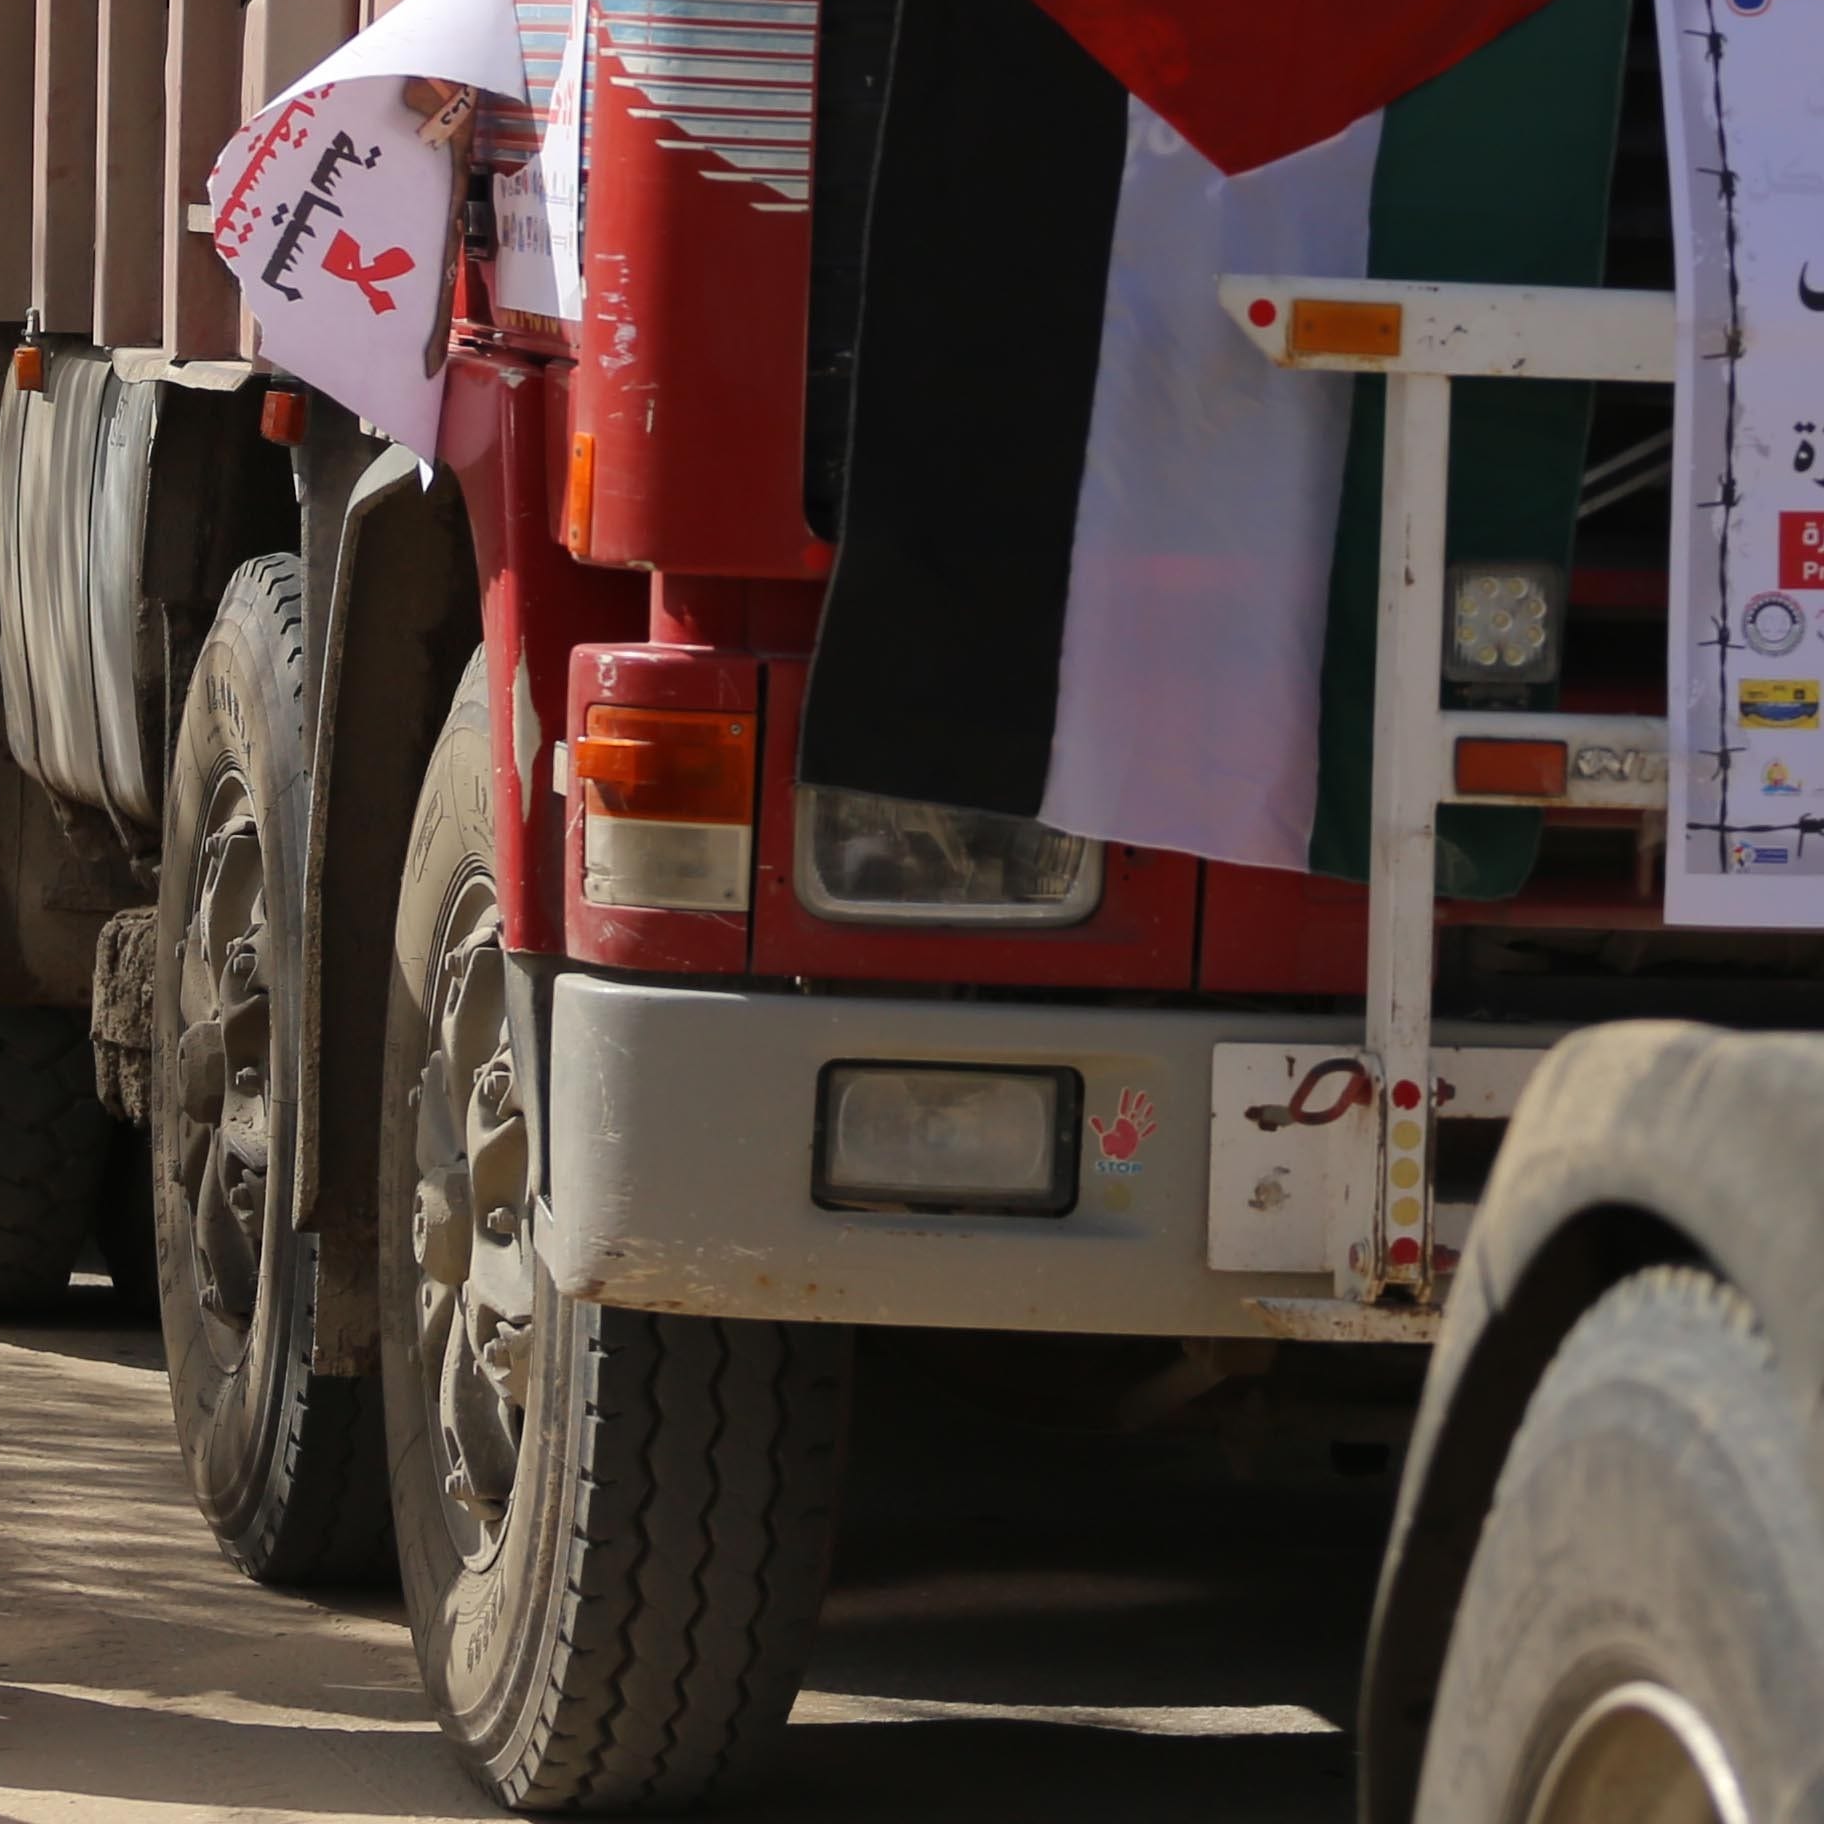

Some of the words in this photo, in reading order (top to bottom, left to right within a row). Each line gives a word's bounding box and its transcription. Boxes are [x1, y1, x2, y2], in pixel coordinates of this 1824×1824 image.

[261, 130, 382, 302] لسياسة
[321, 229, 416, 315] لا
[1095, 1160, 1143, 1175] STOP
